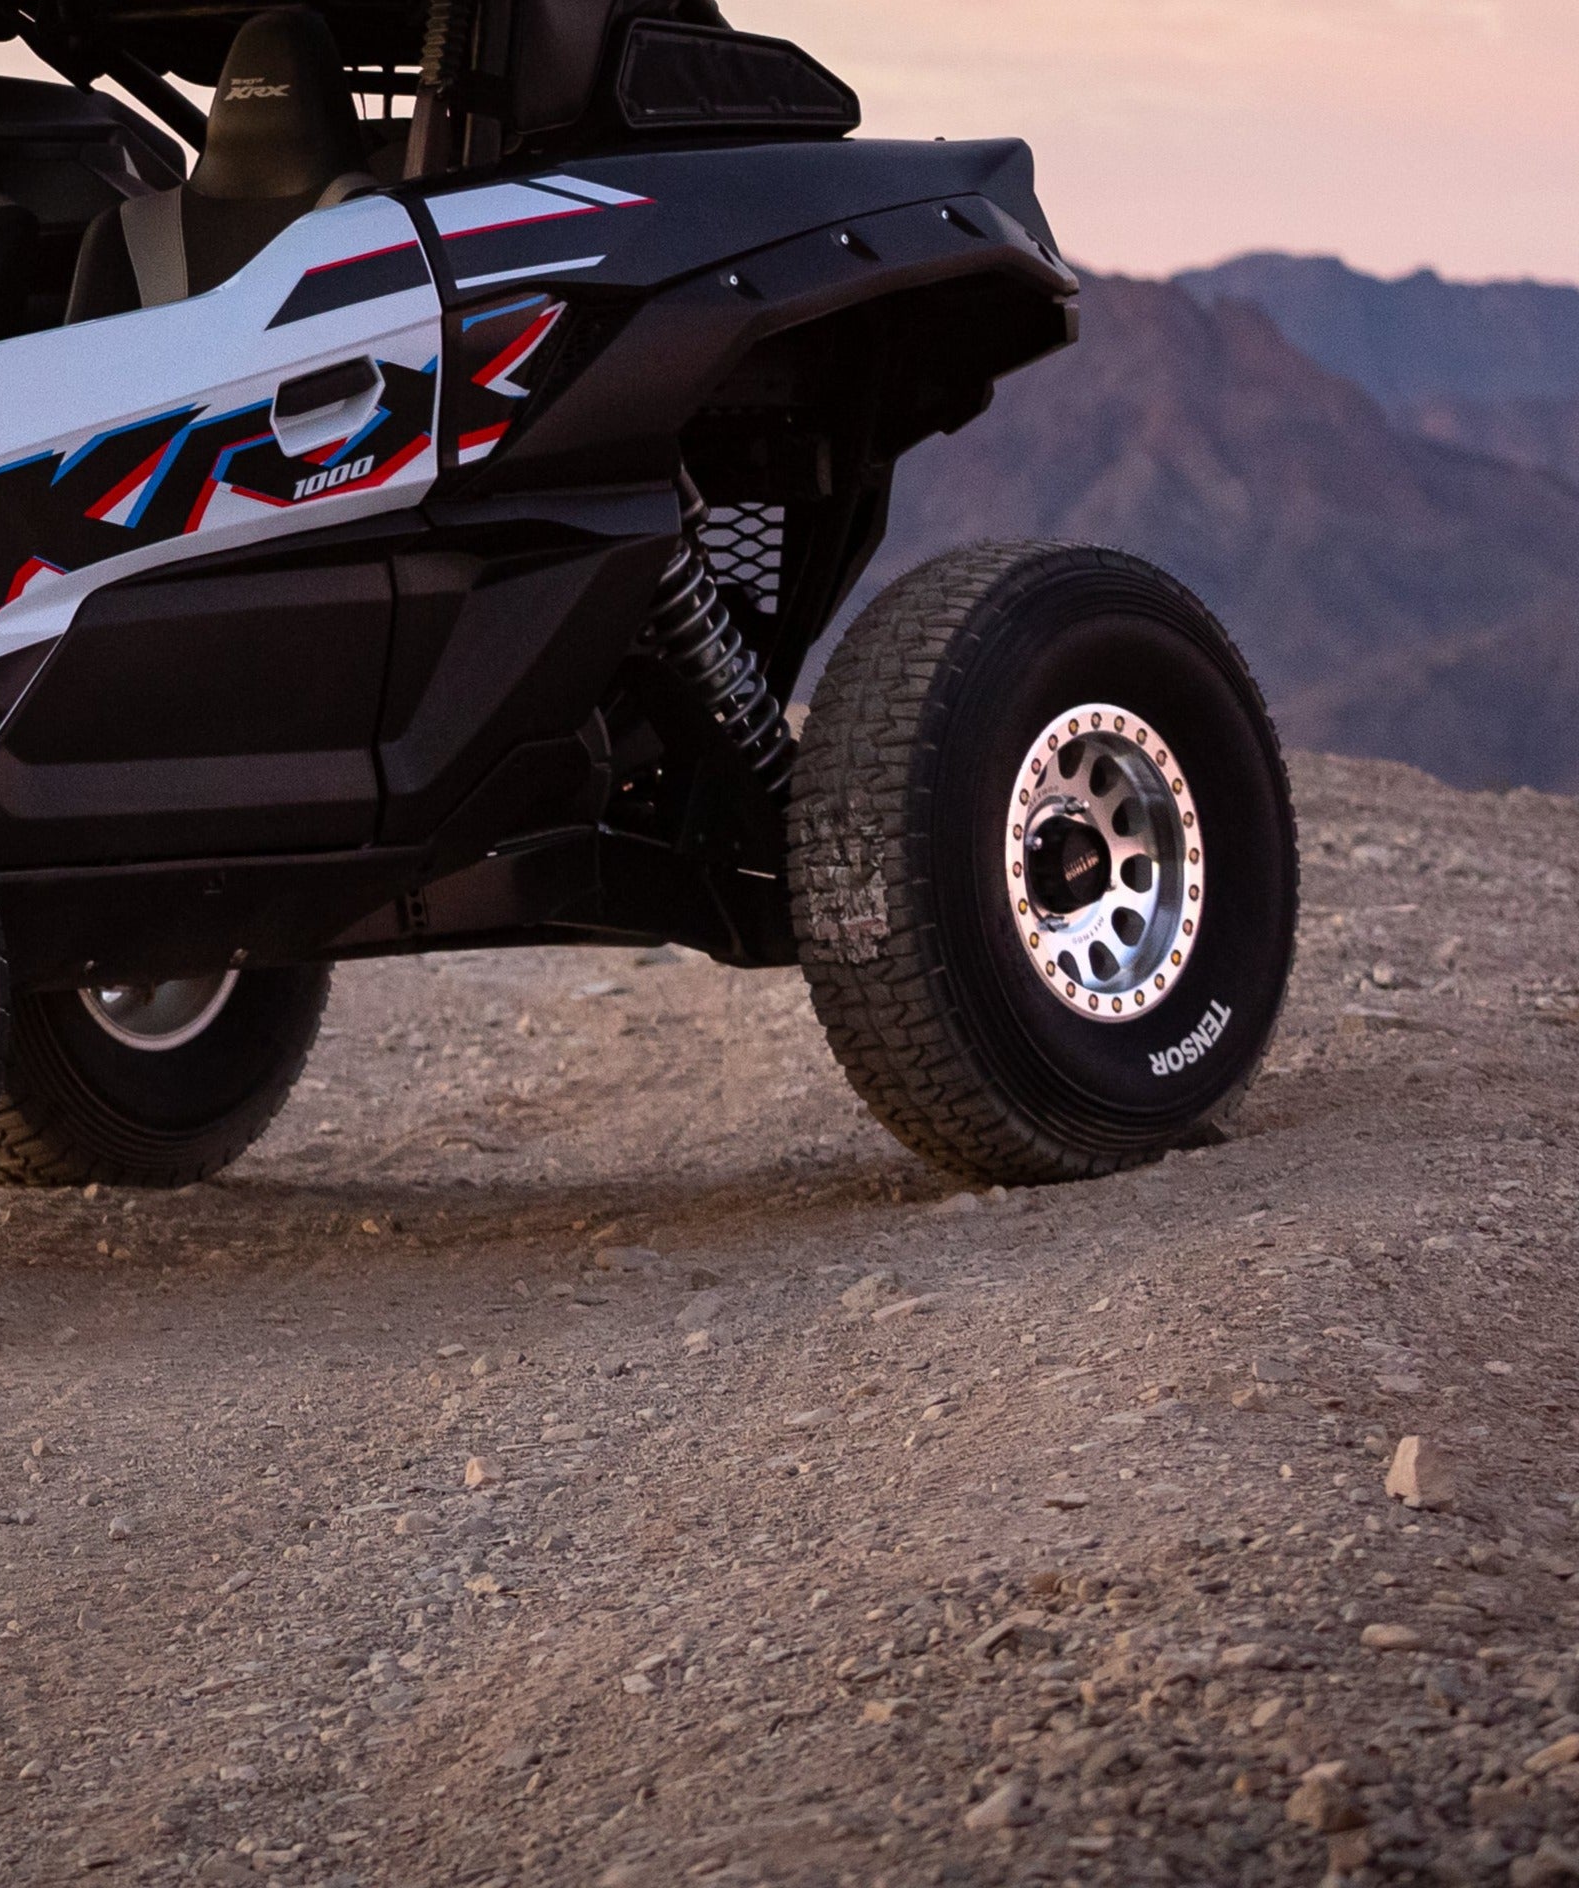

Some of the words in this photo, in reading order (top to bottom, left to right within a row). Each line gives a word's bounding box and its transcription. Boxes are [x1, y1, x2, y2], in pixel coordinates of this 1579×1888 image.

[224, 84, 291, 101] KRX
[293, 455, 374, 501] 1000
[1148, 999, 1232, 1076] TENSOR
